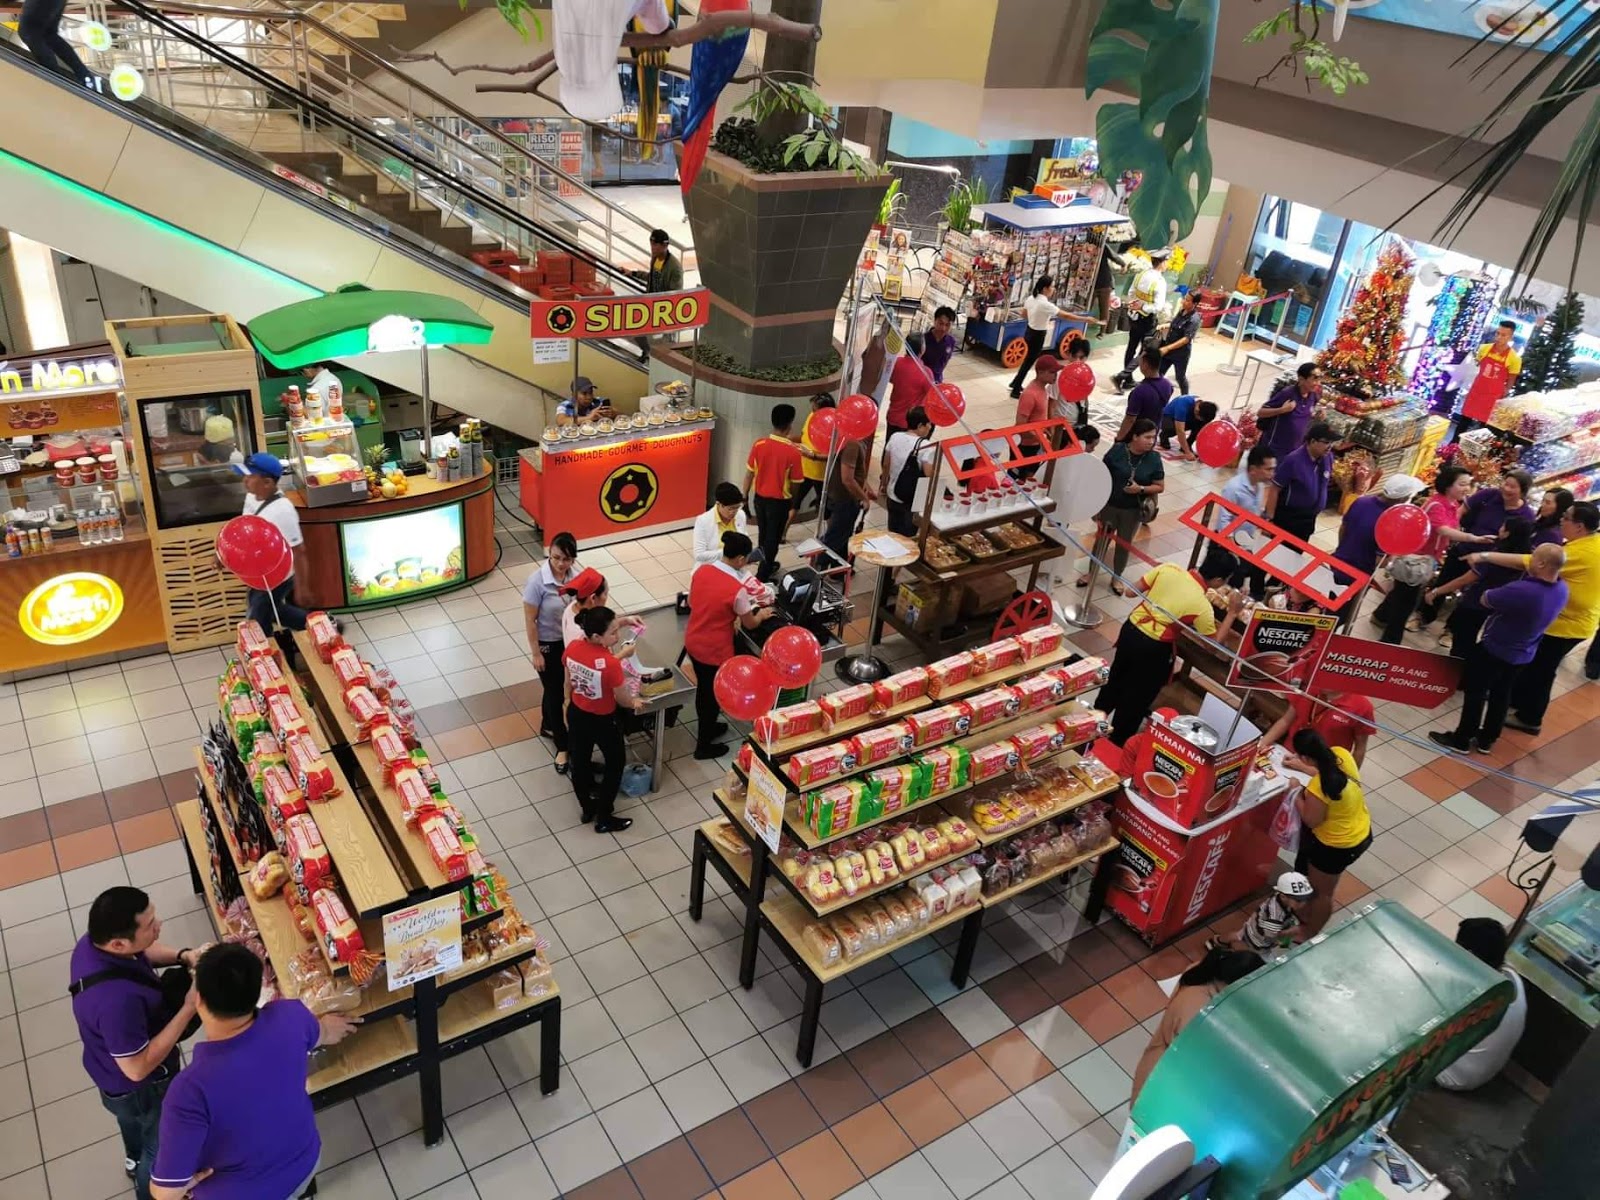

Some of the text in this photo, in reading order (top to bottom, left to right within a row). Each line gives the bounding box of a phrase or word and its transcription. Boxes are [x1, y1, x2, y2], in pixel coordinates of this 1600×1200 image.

[531, 134, 555, 144] RISO
[585, 296, 699, 333] SIDRO
[554, 433, 703, 466] HANDMADE GOURMET DOUGHNUTS
[1259, 638, 1304, 648] ORIGINAL
[1320, 662, 1449, 694] MATAPANG MONG KAPE?
[1326, 651, 1430, 678] MASARAP BA ANG
[1149, 725, 1186, 754] TIKMAN
[1187, 750, 1206, 765] NA!
